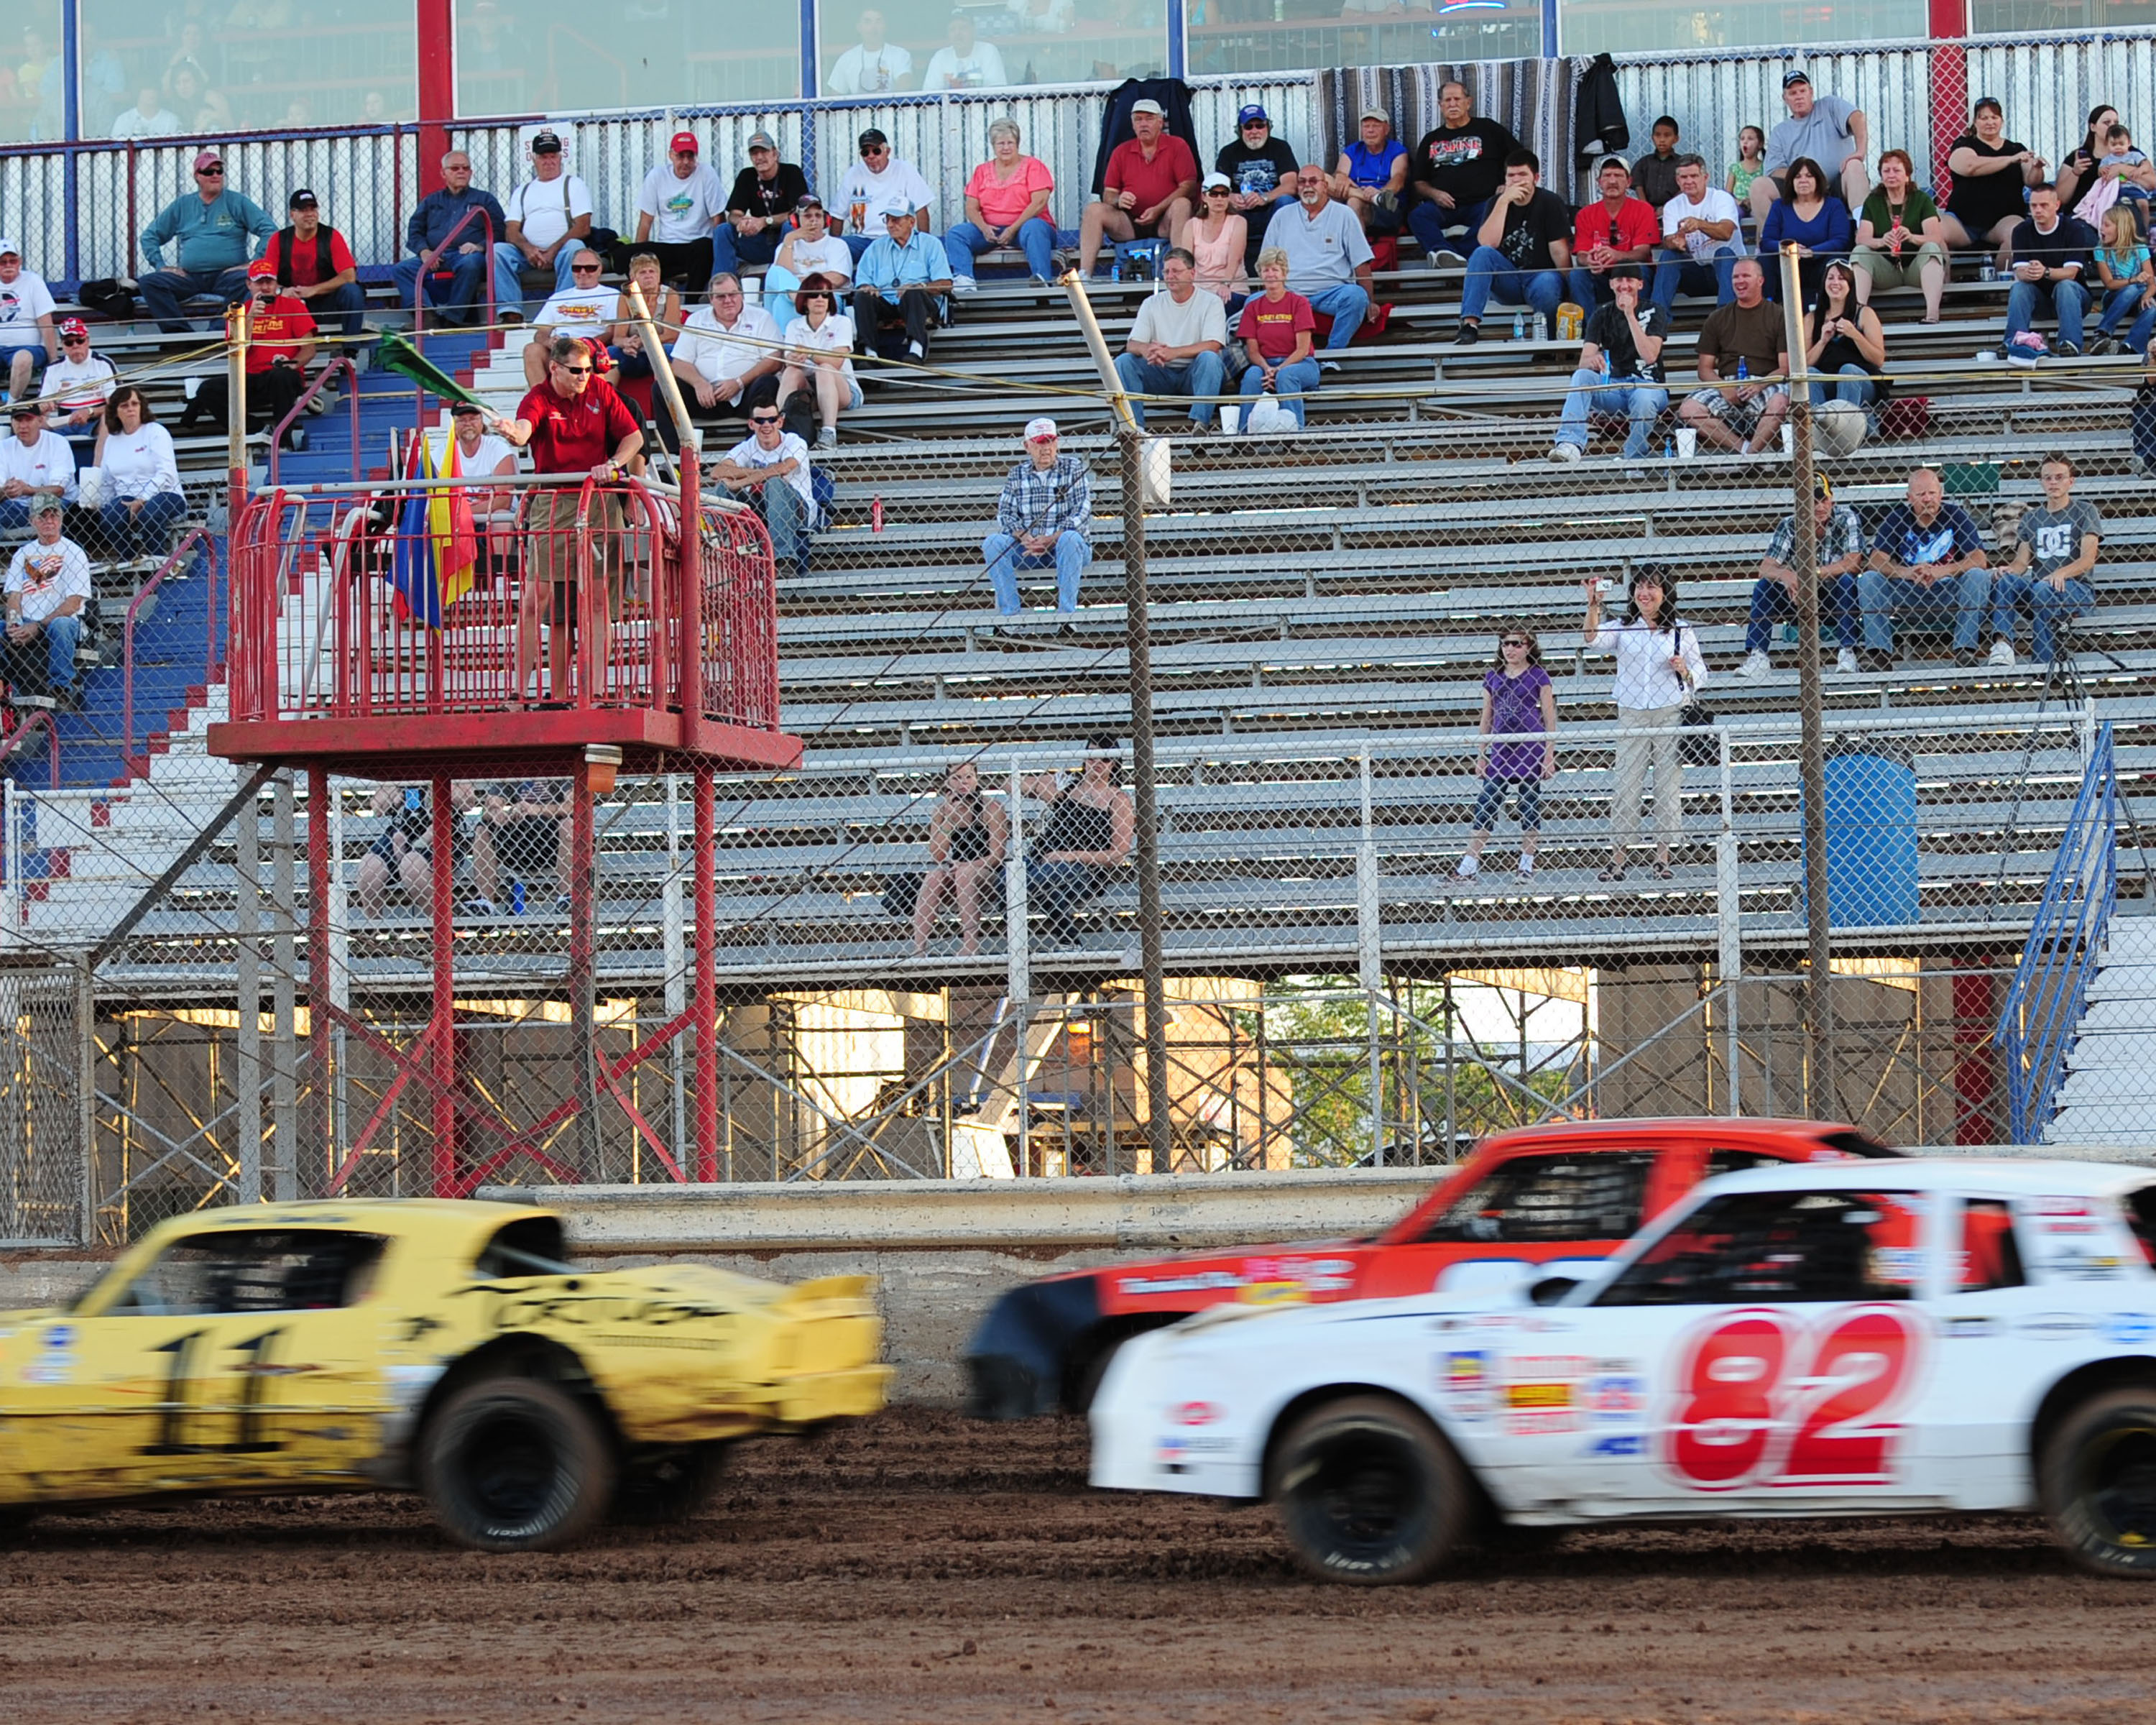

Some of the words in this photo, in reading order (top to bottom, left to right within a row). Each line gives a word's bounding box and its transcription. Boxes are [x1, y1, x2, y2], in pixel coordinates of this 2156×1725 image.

[2037, 524, 2071, 559] DC
[137, 1327, 291, 1456] 11
[1671, 1307, 1917, 1489] 82
